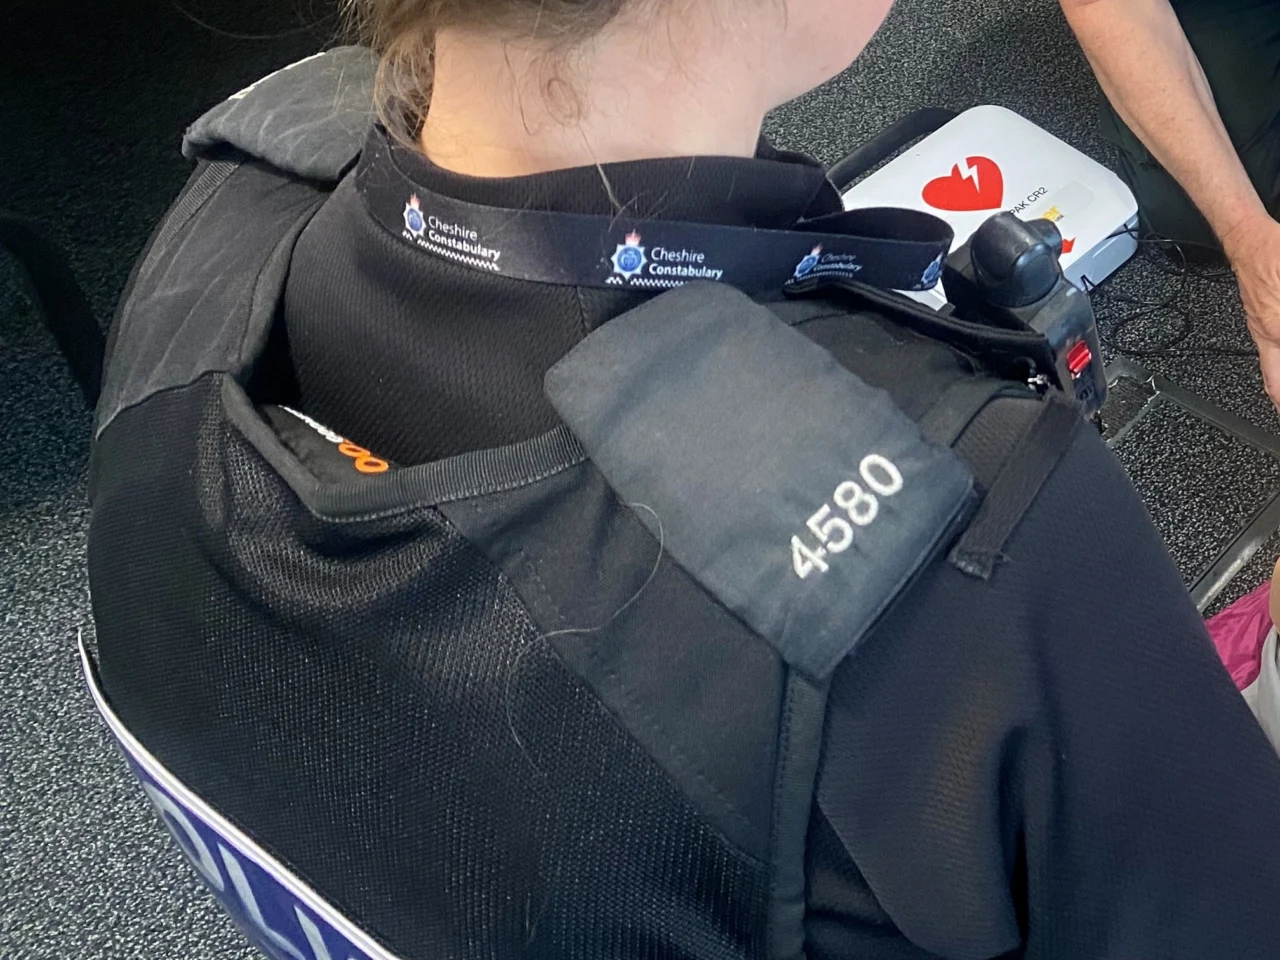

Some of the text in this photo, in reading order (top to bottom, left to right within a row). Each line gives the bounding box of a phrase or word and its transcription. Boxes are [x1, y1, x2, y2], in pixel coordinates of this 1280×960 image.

[1026, 186, 1049, 203] CR2
[427, 216, 478, 241] Cheshire
[428, 230, 502, 262] Constabulary
[651, 247, 706, 263] Cheshire
[648, 263, 725, 280] Constabulary
[790, 454, 904, 579] 4580
